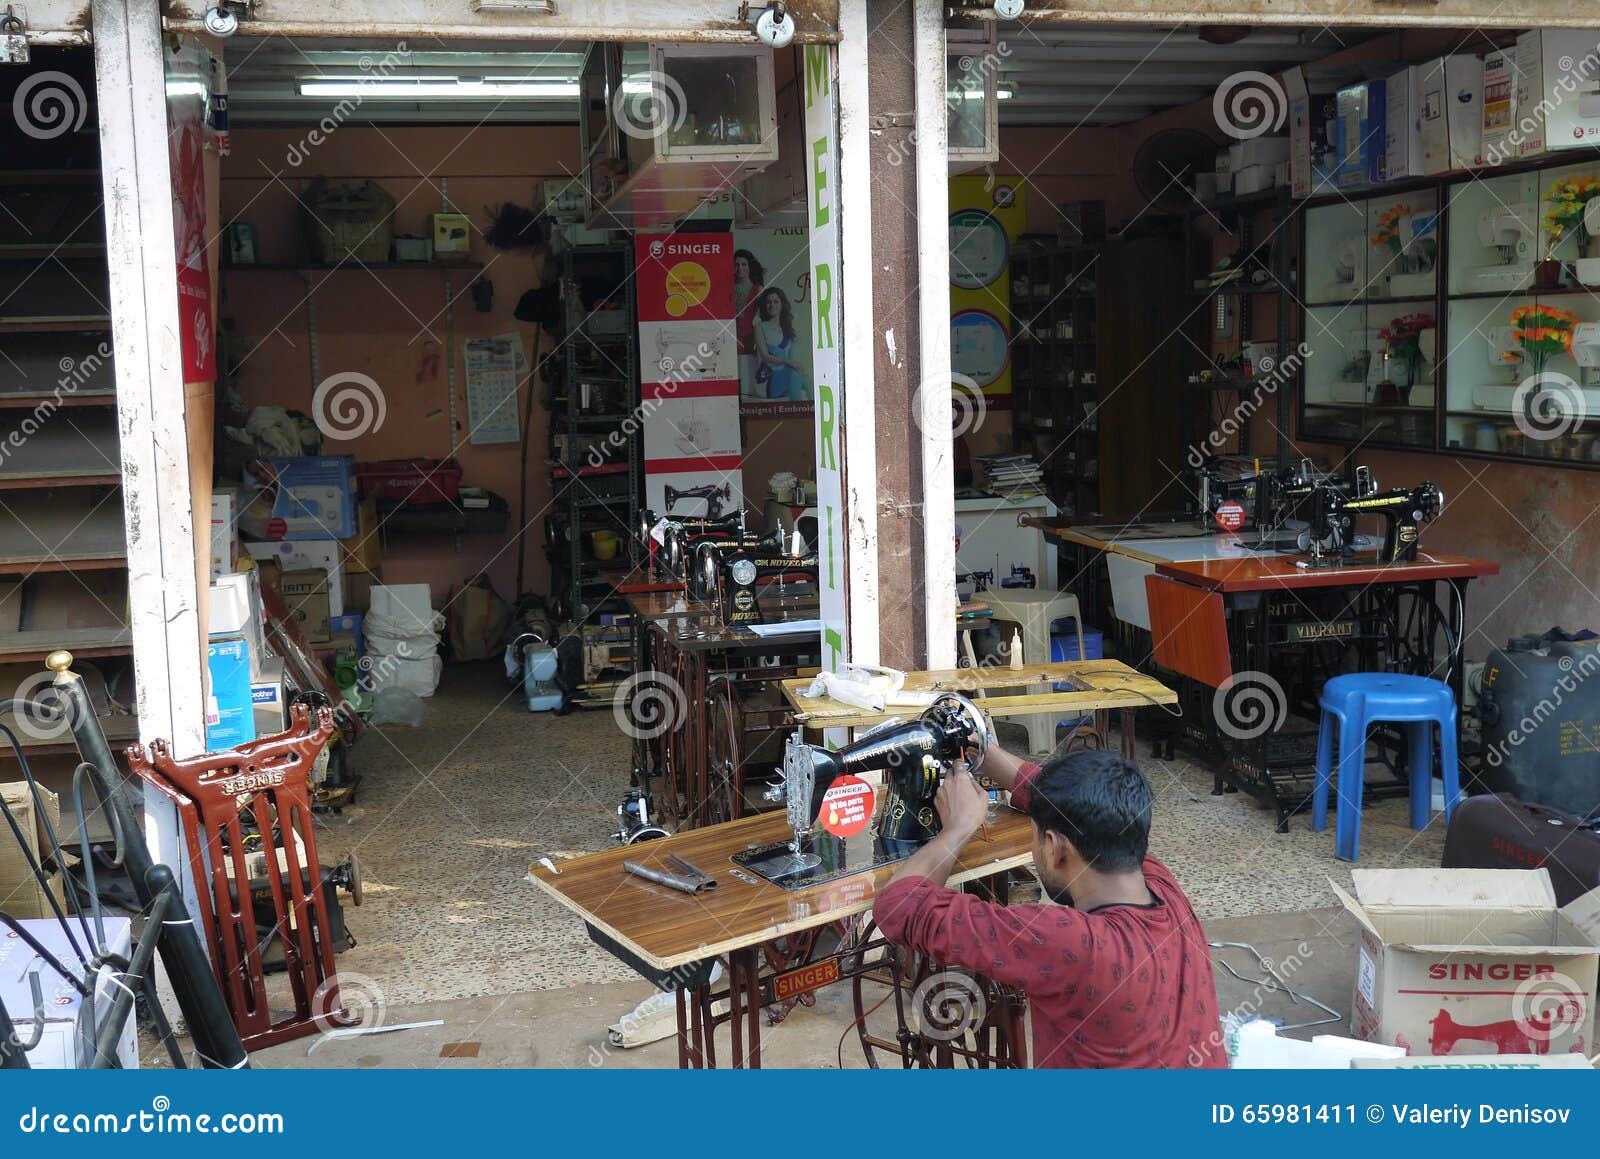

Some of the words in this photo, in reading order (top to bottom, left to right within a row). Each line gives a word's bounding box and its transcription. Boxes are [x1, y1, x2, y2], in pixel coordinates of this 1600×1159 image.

[668, 243, 721, 255] SINGER
[805, 43, 843, 674] MERRIT
[1297, 623, 1353, 637] VIKRANT
[833, 786, 863, 796] SINGER
[779, 965, 835, 995] SINGER
[1428, 962, 1556, 982] SINGER
